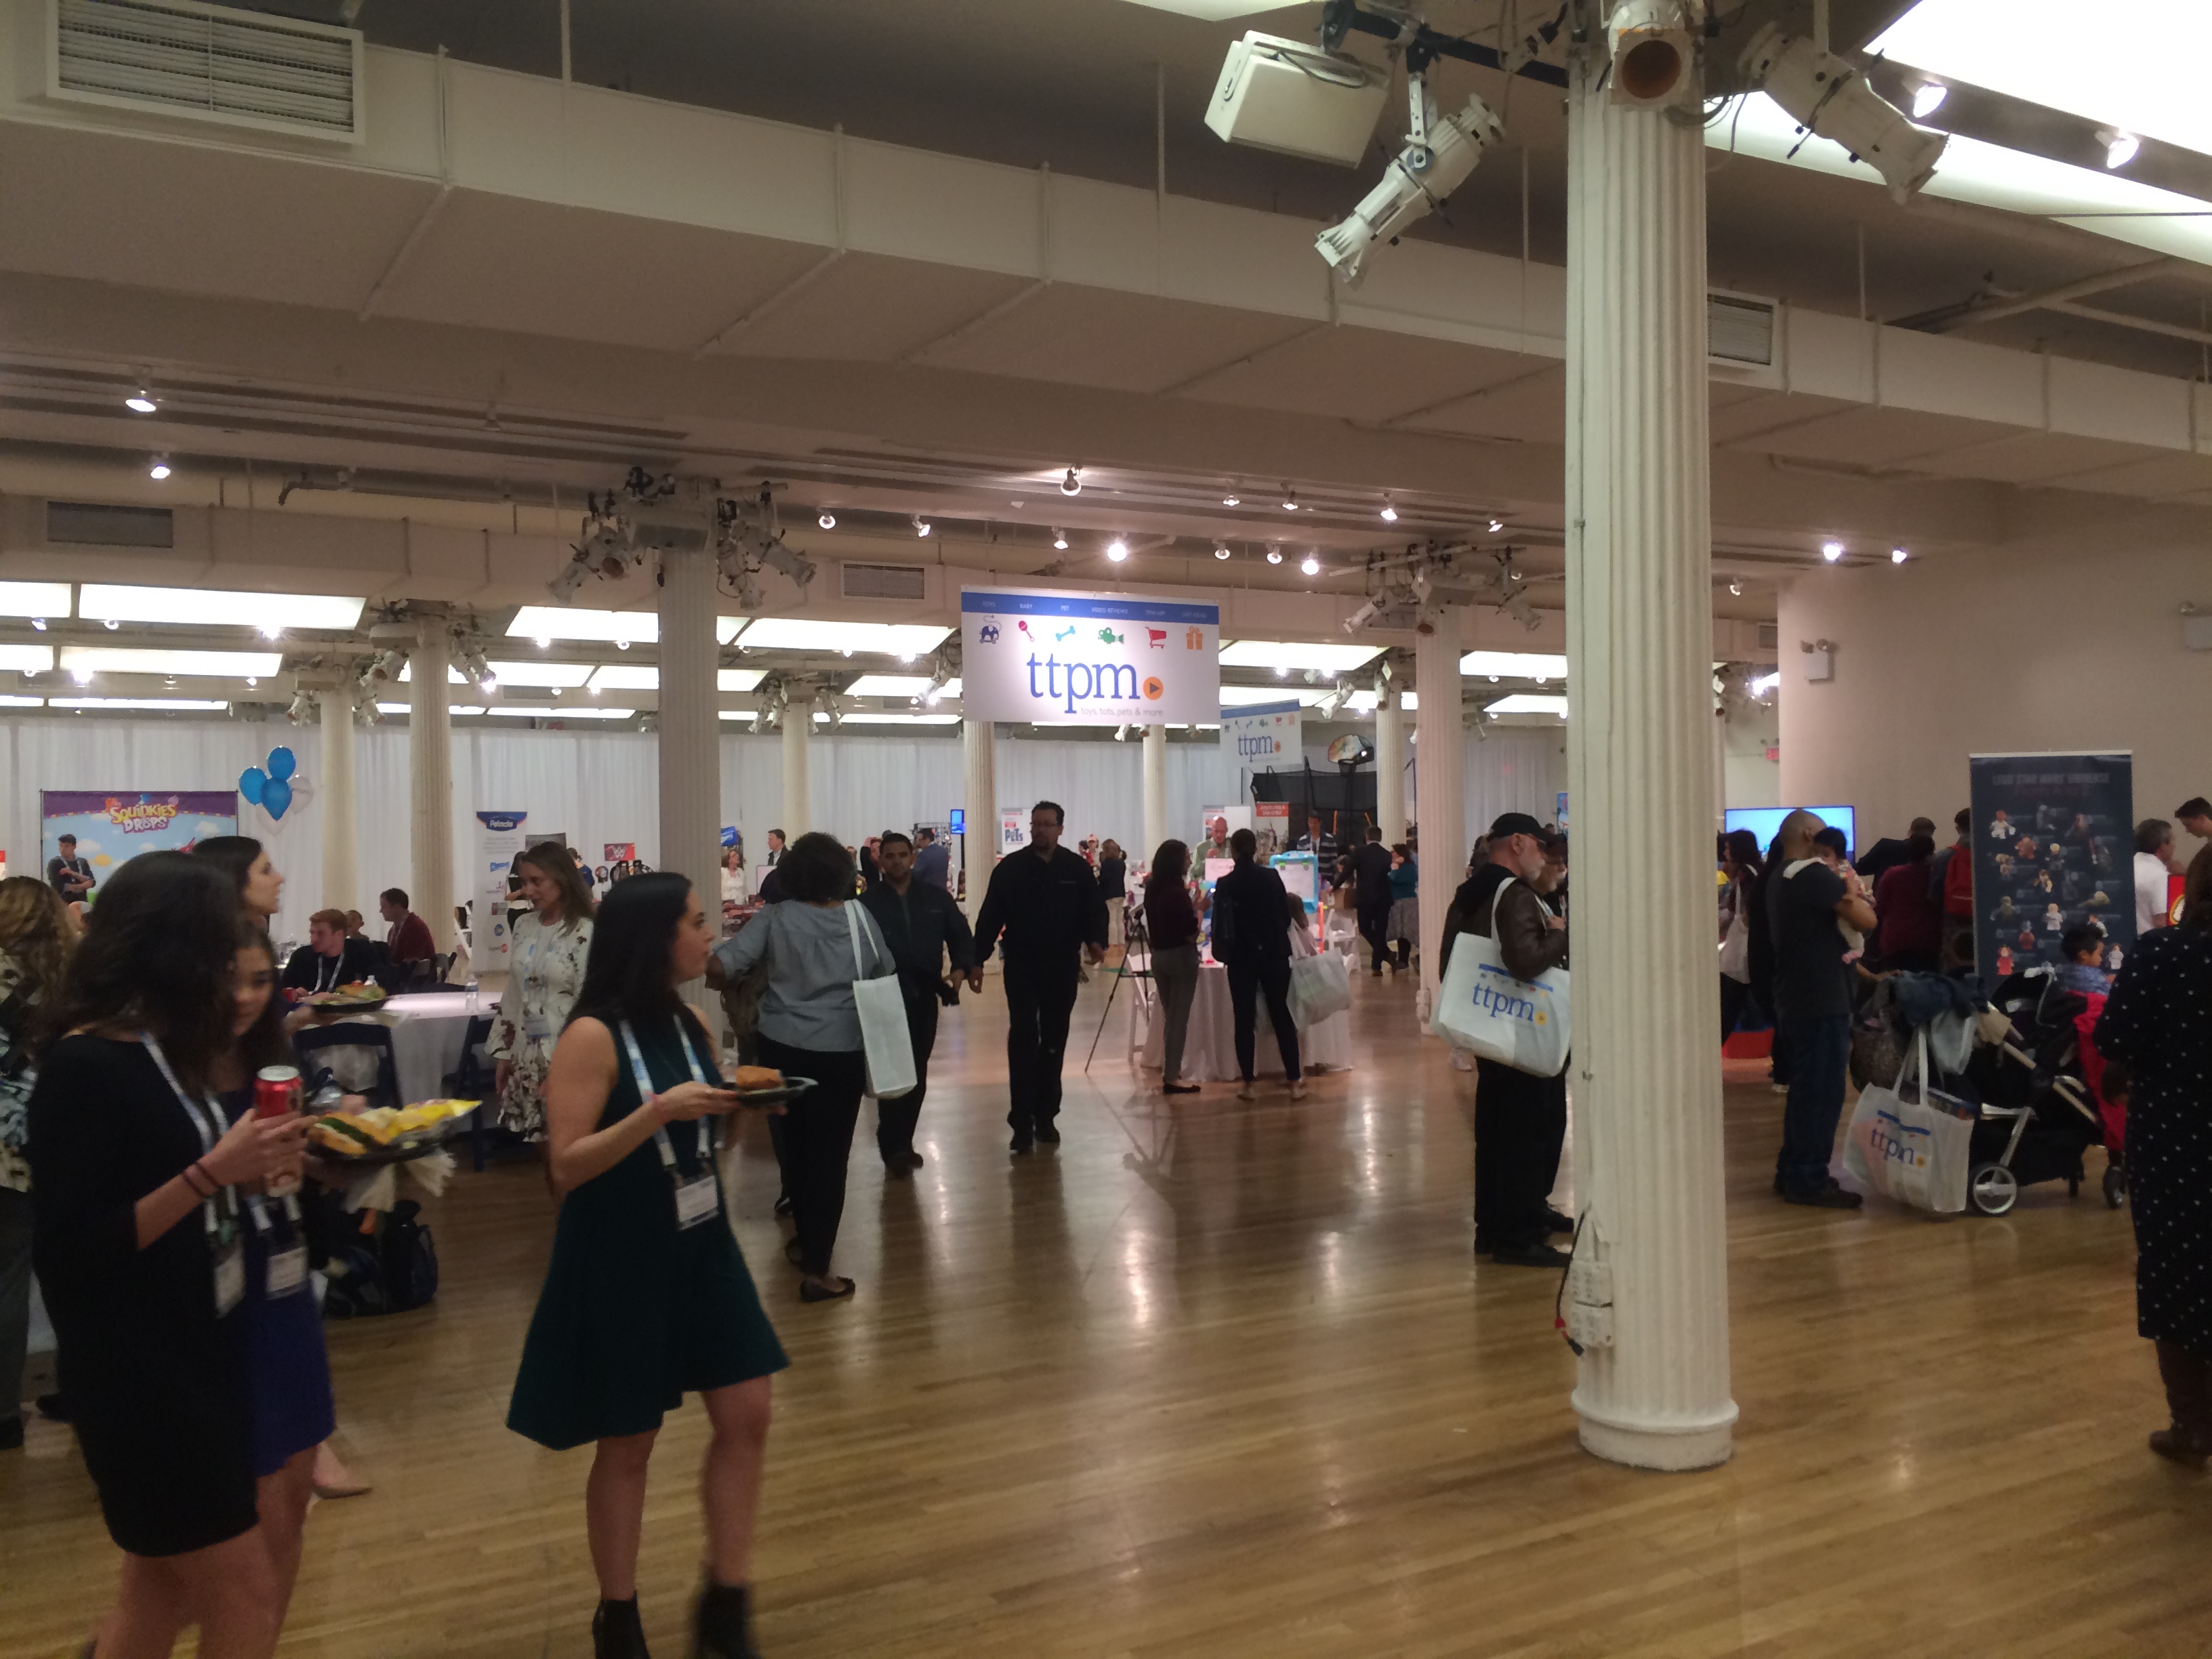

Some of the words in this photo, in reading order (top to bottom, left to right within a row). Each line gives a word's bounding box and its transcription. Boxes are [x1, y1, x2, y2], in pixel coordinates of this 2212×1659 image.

[1027, 653, 1141, 714] ttpm
[1237, 733, 1273, 762] ttpm
[1473, 982, 1534, 1022] ttpm
